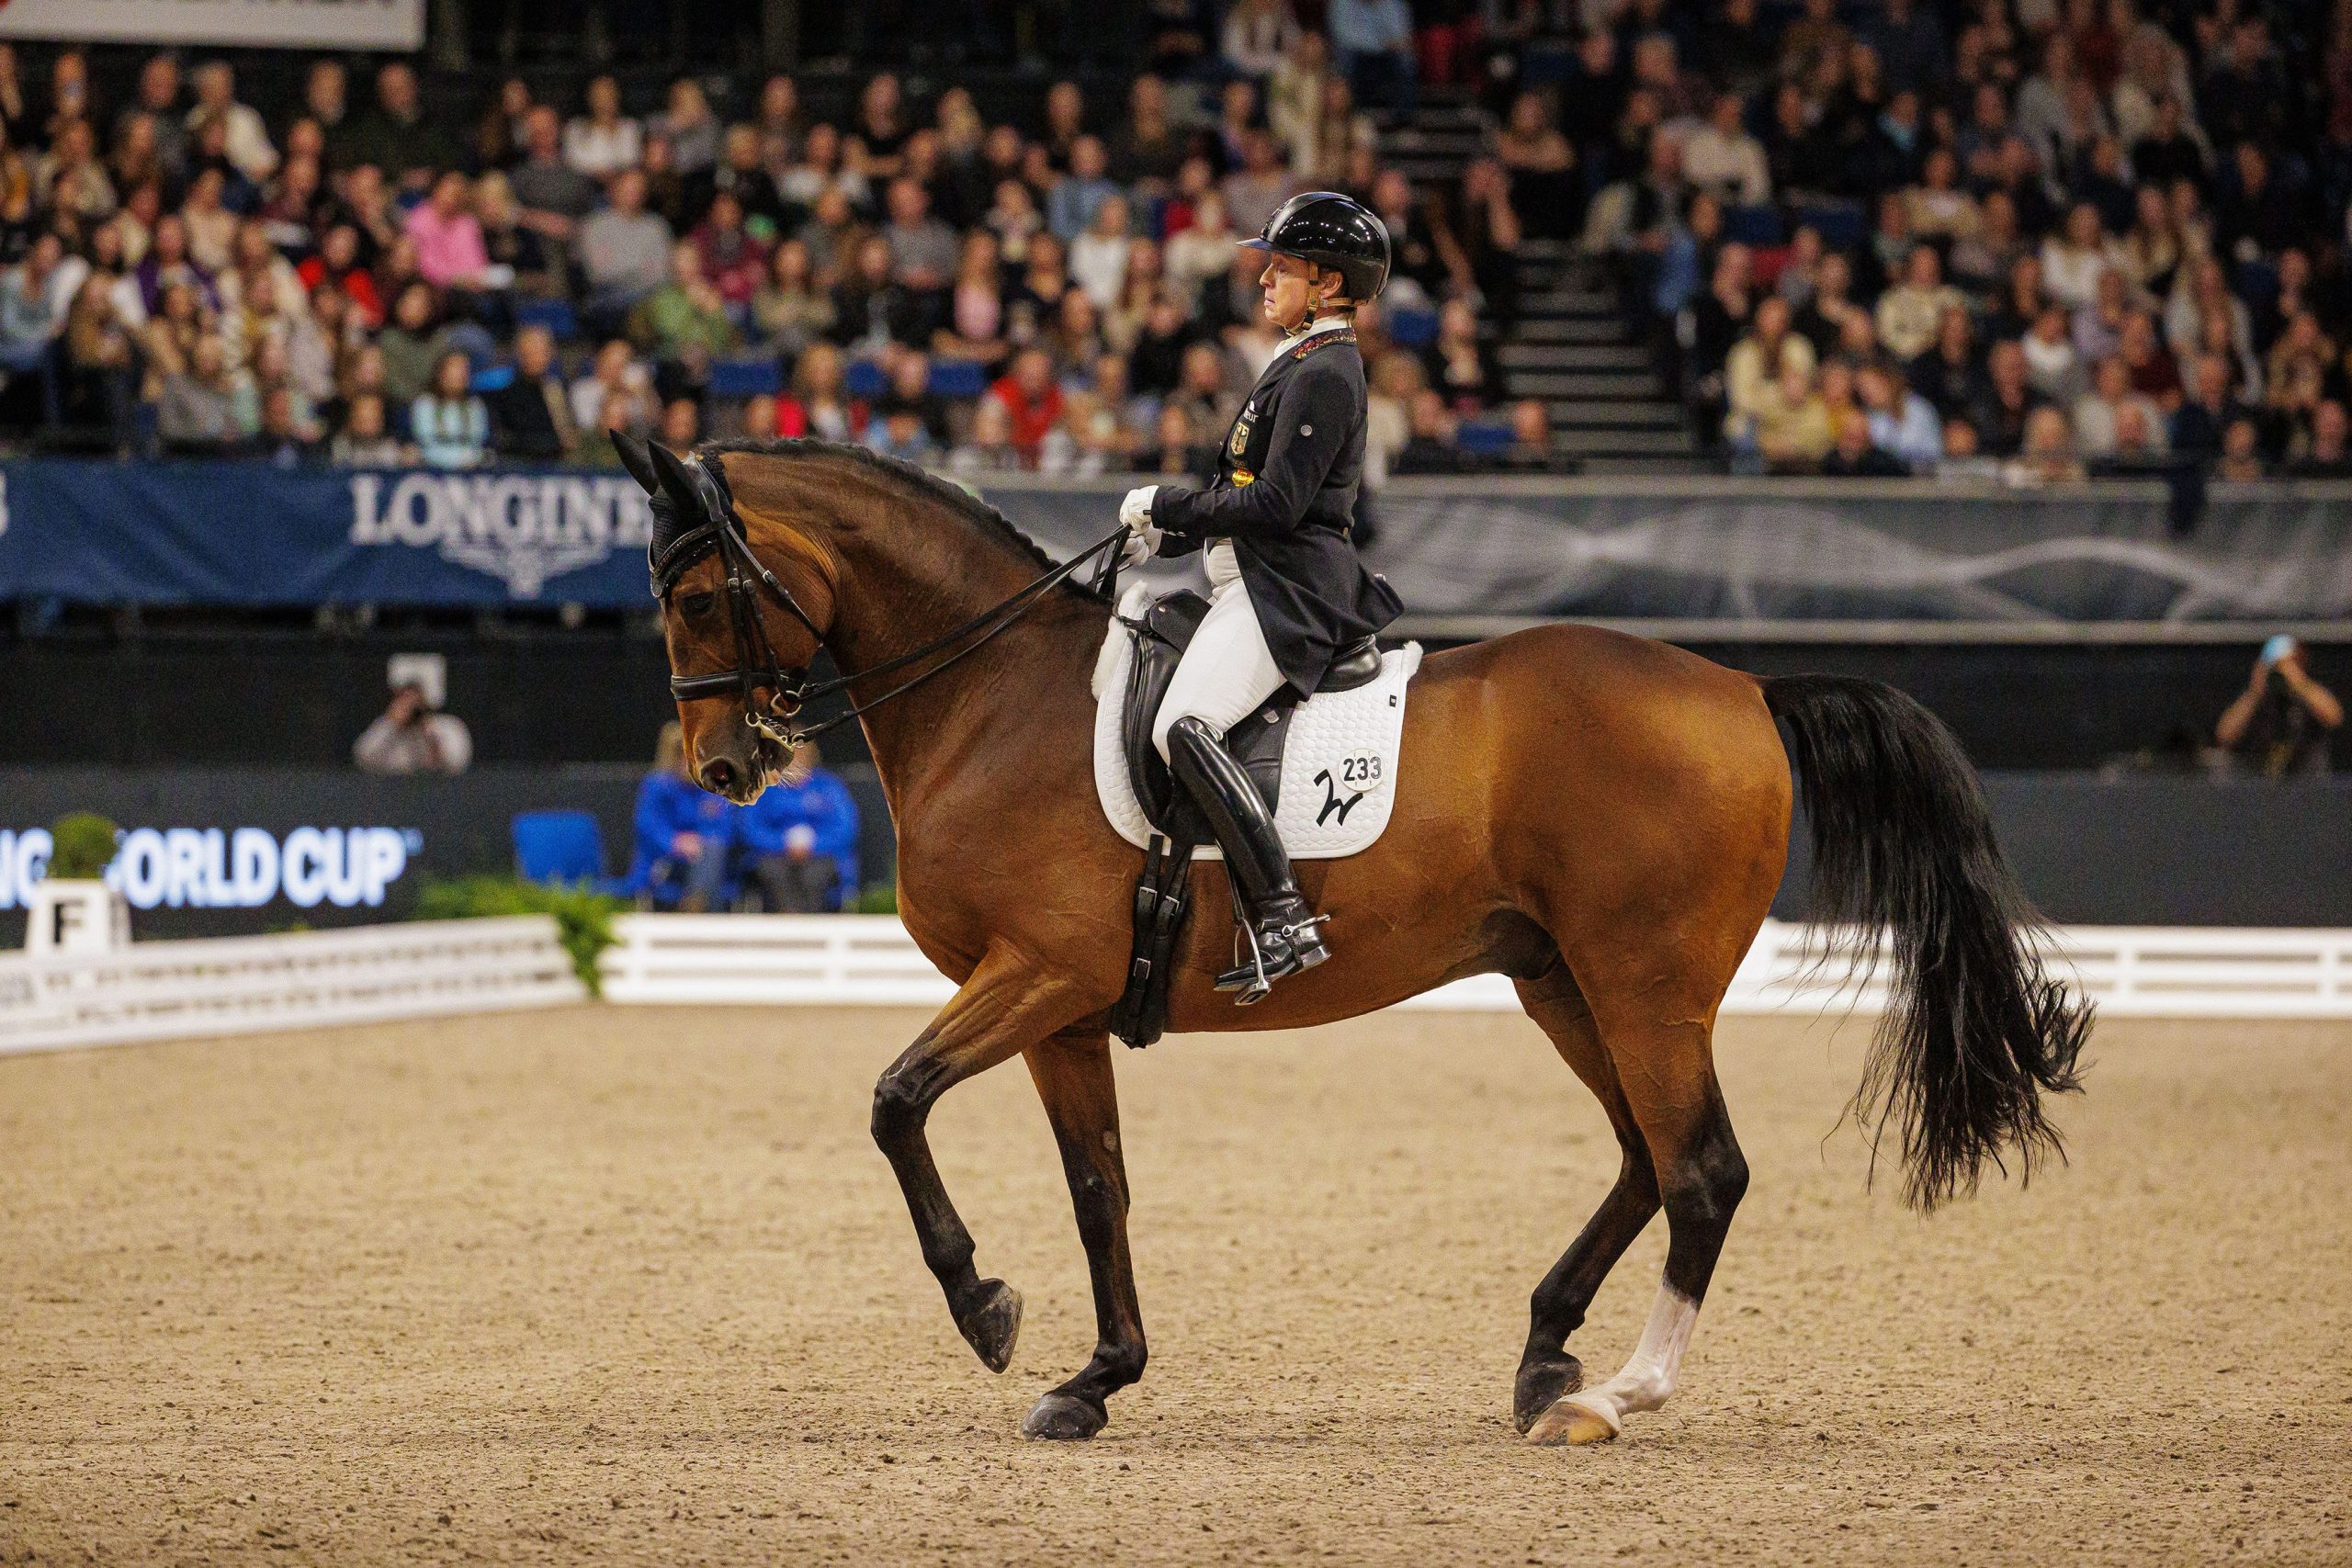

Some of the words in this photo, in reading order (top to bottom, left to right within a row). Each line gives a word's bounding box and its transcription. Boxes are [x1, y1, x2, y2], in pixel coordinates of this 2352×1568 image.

[351, 473, 653, 546] LONGINE
[1343, 756, 1382, 782] 233
[104, 827, 280, 908] ORLD
[282, 826, 406, 908] CUP
[52, 897, 85, 944] F
